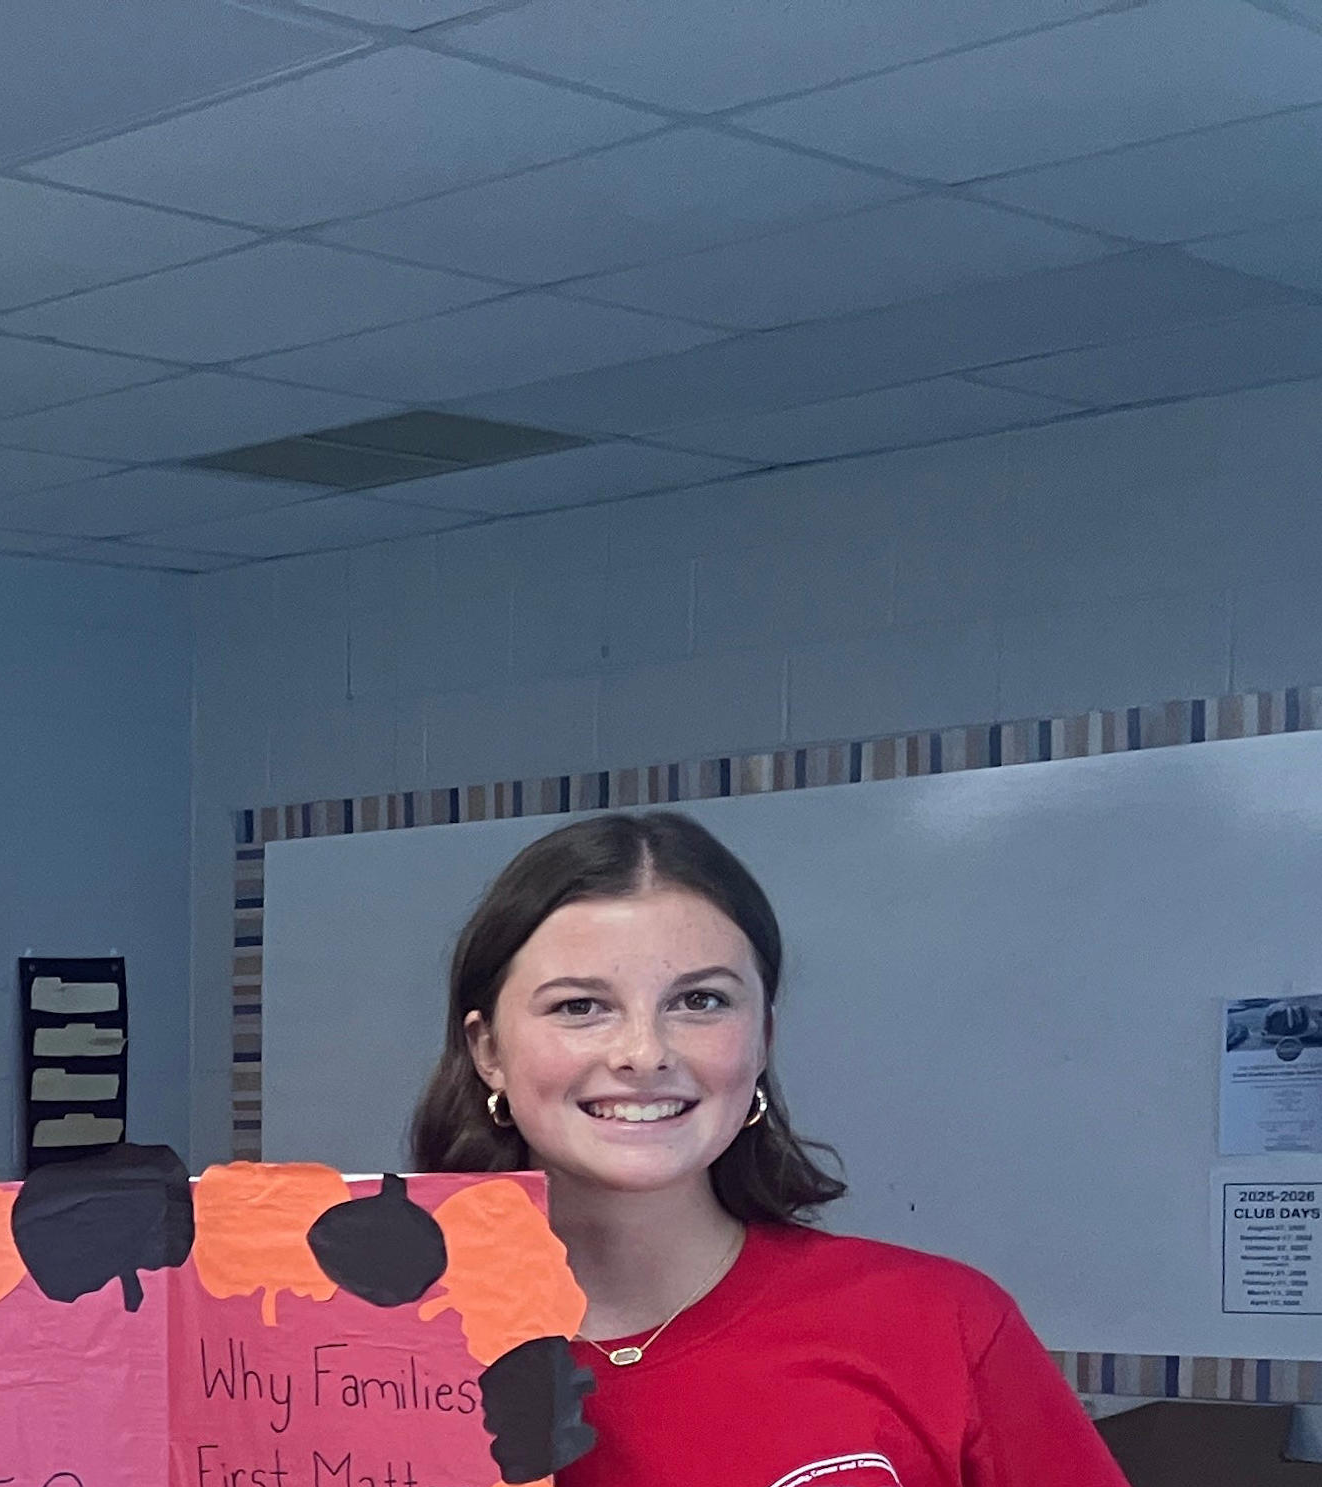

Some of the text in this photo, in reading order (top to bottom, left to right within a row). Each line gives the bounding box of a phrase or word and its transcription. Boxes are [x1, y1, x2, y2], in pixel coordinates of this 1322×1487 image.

[1239, 1190, 1315, 1202] 2025-2026
[1234, 1208, 1320, 1219] CLUB DAYS
[200, 1337, 479, 1433] Why Families
